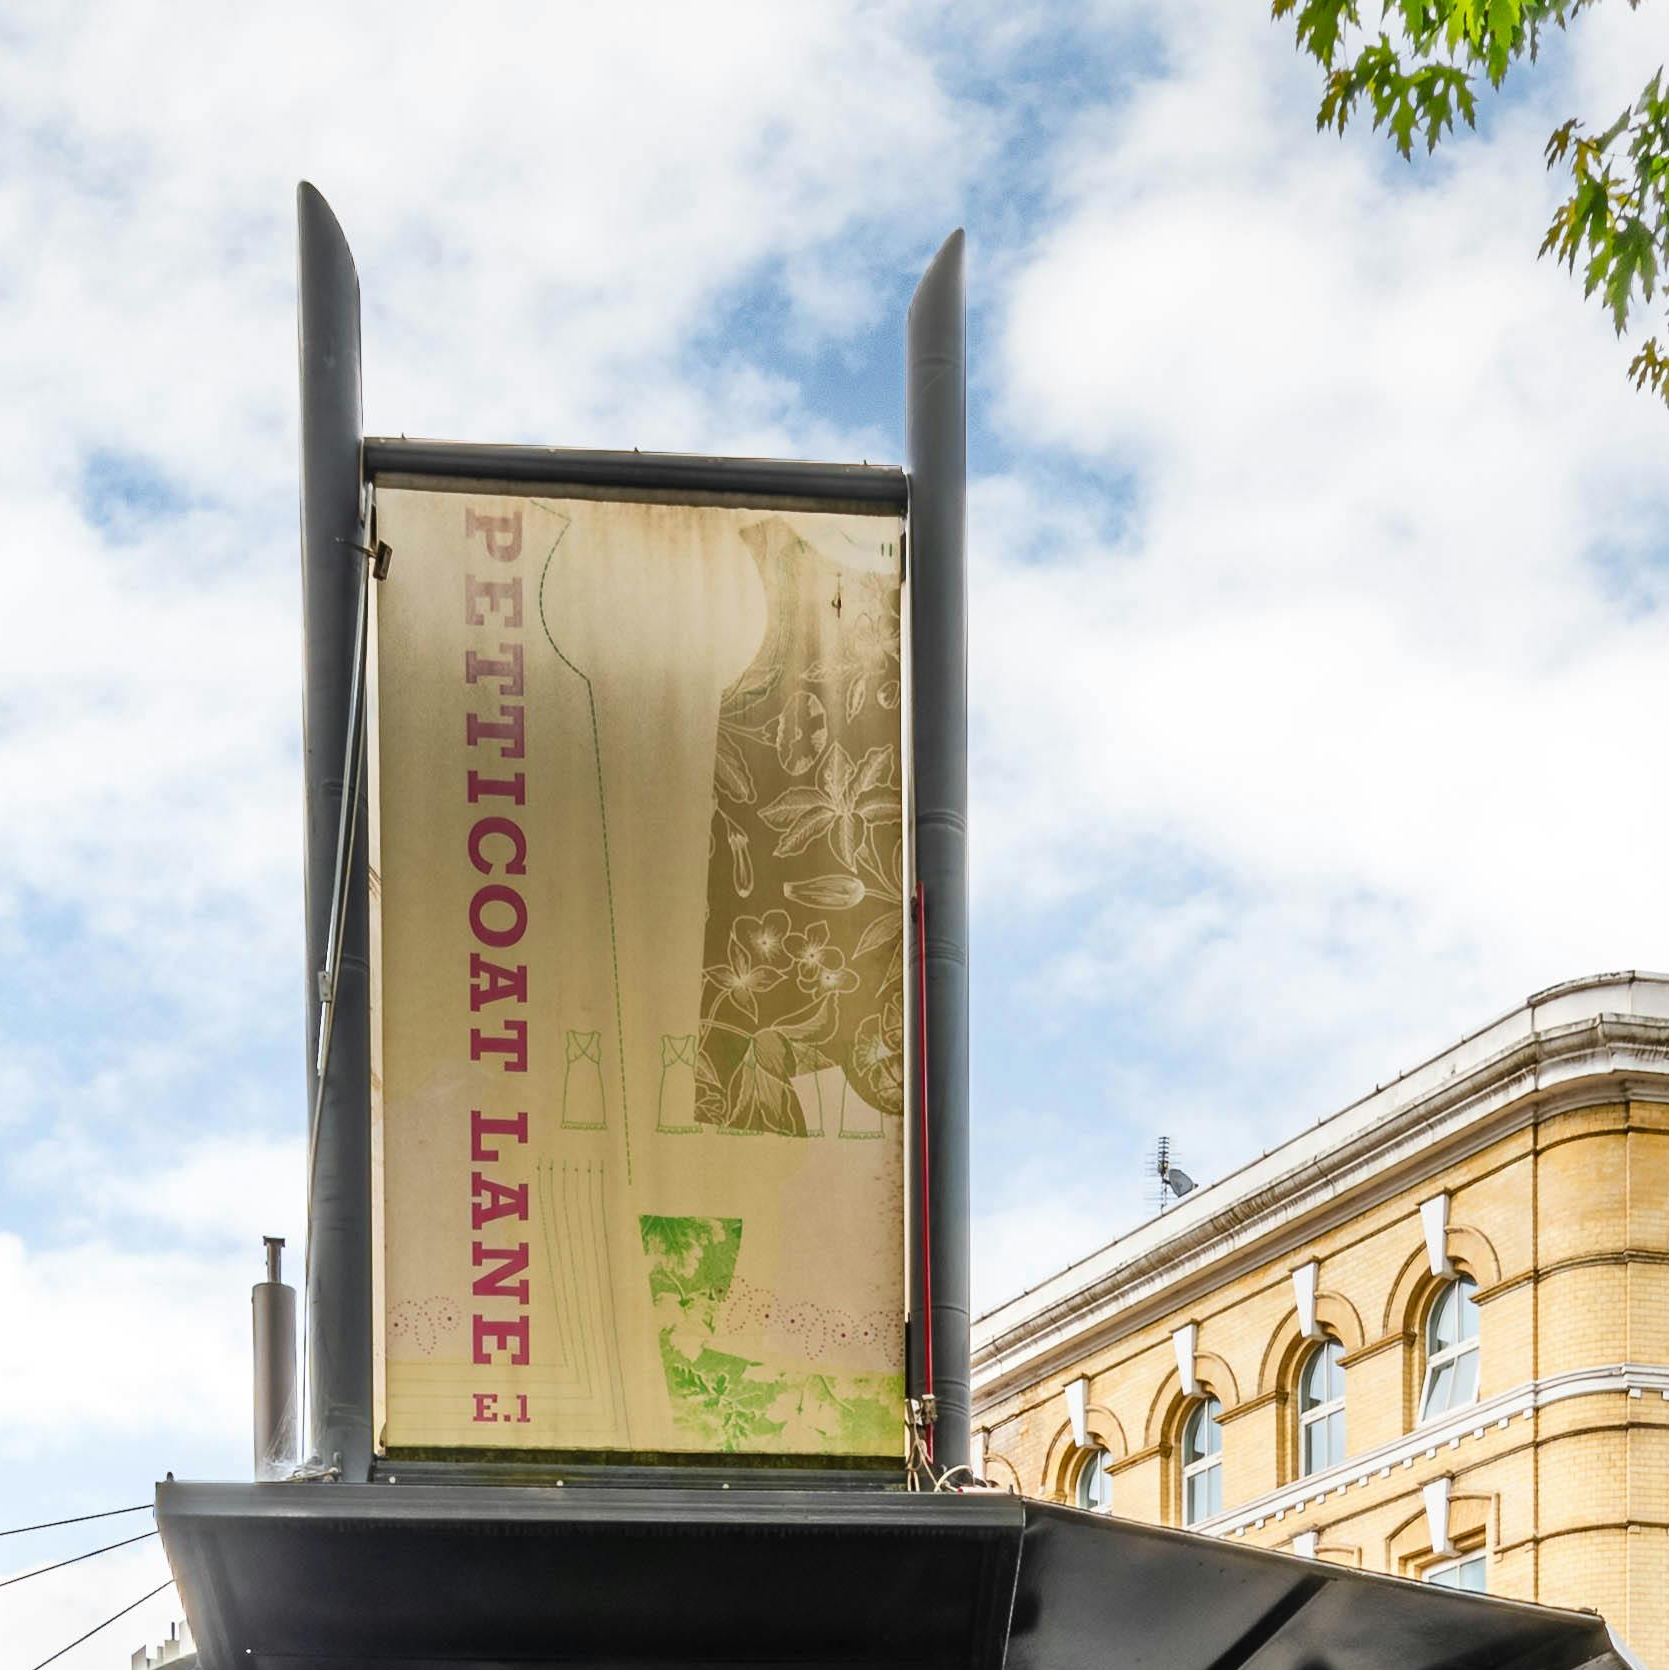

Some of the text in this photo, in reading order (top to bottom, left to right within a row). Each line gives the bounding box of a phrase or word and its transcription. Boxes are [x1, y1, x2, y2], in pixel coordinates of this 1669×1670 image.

[464, 504, 530, 1366] PETTICOAT LANE
[472, 1393, 531, 1423] E.1
